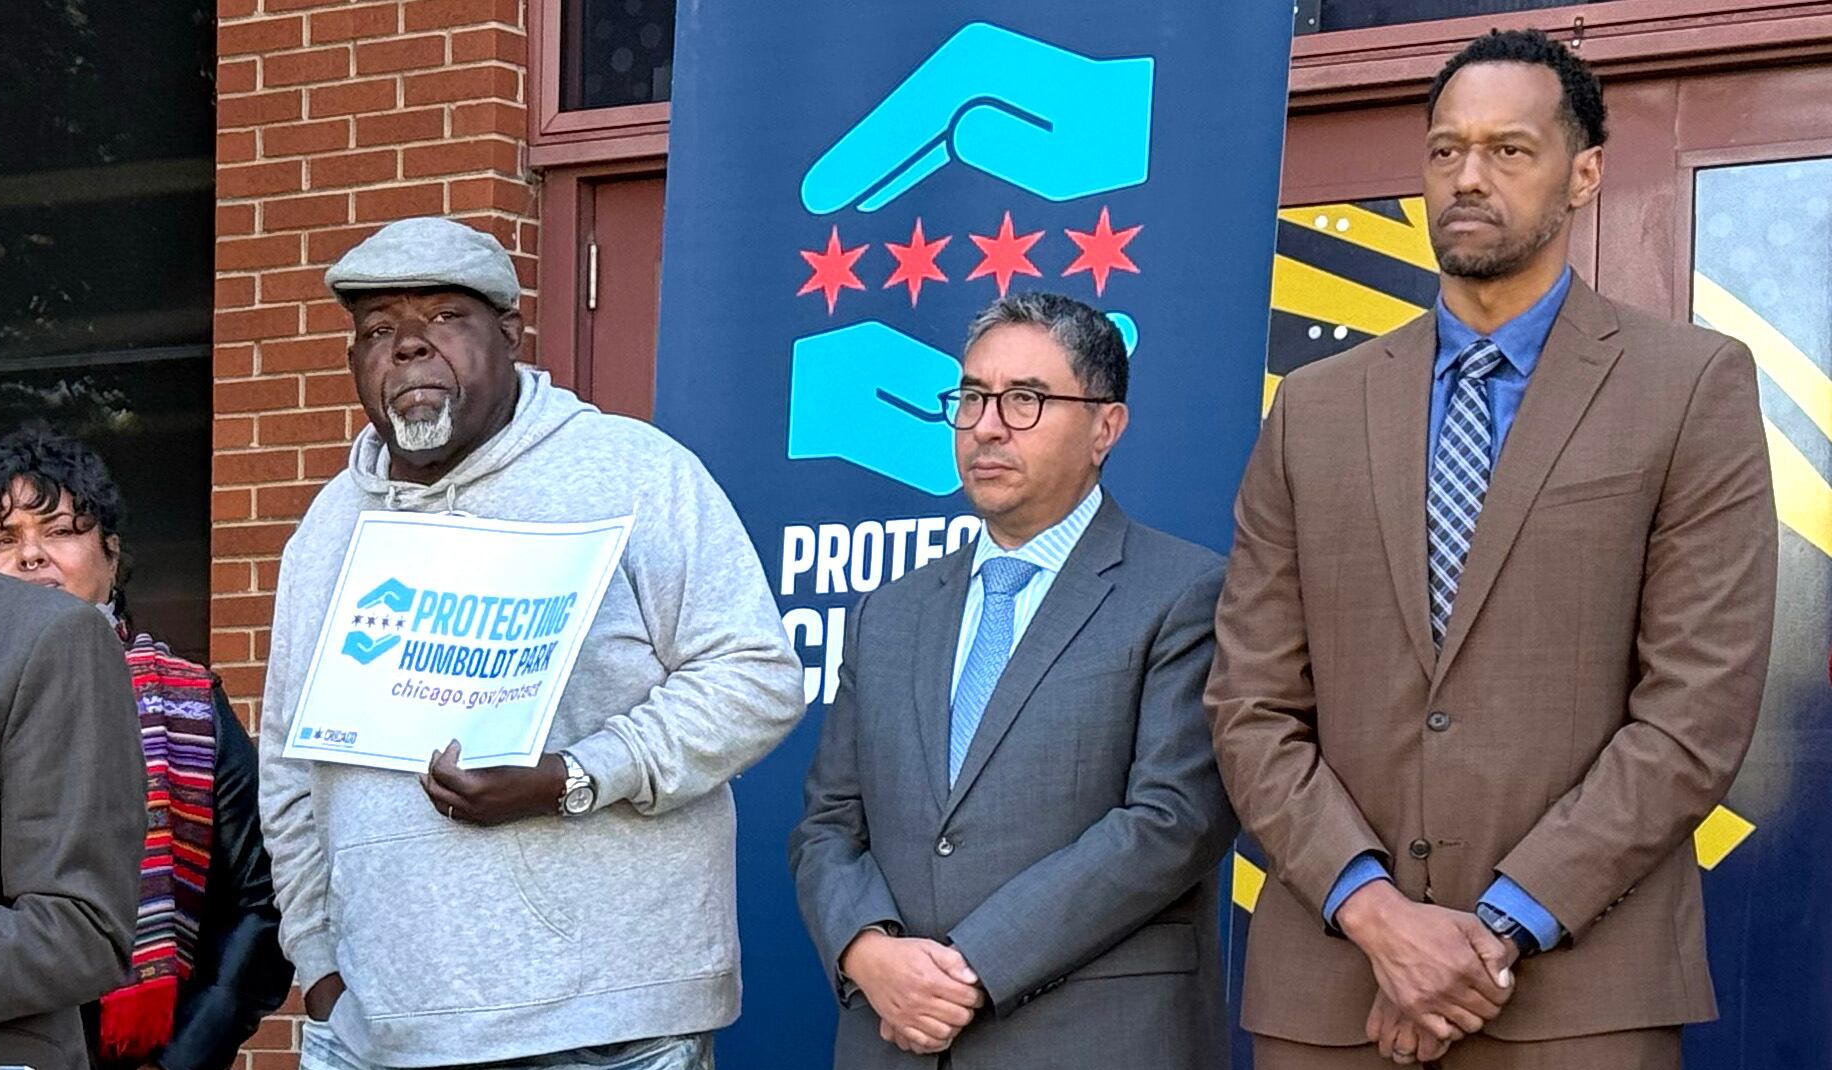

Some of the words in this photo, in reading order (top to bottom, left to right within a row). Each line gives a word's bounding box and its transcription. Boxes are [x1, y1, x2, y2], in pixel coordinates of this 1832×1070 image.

[780, 514, 983, 596] PROTEC
[411, 590, 578, 641] PROTECTING
[397, 640, 518, 679] HUMBOLDT
[514, 641, 559, 677] PARK
[391, 680, 543, 708] chicago.gov/protect
